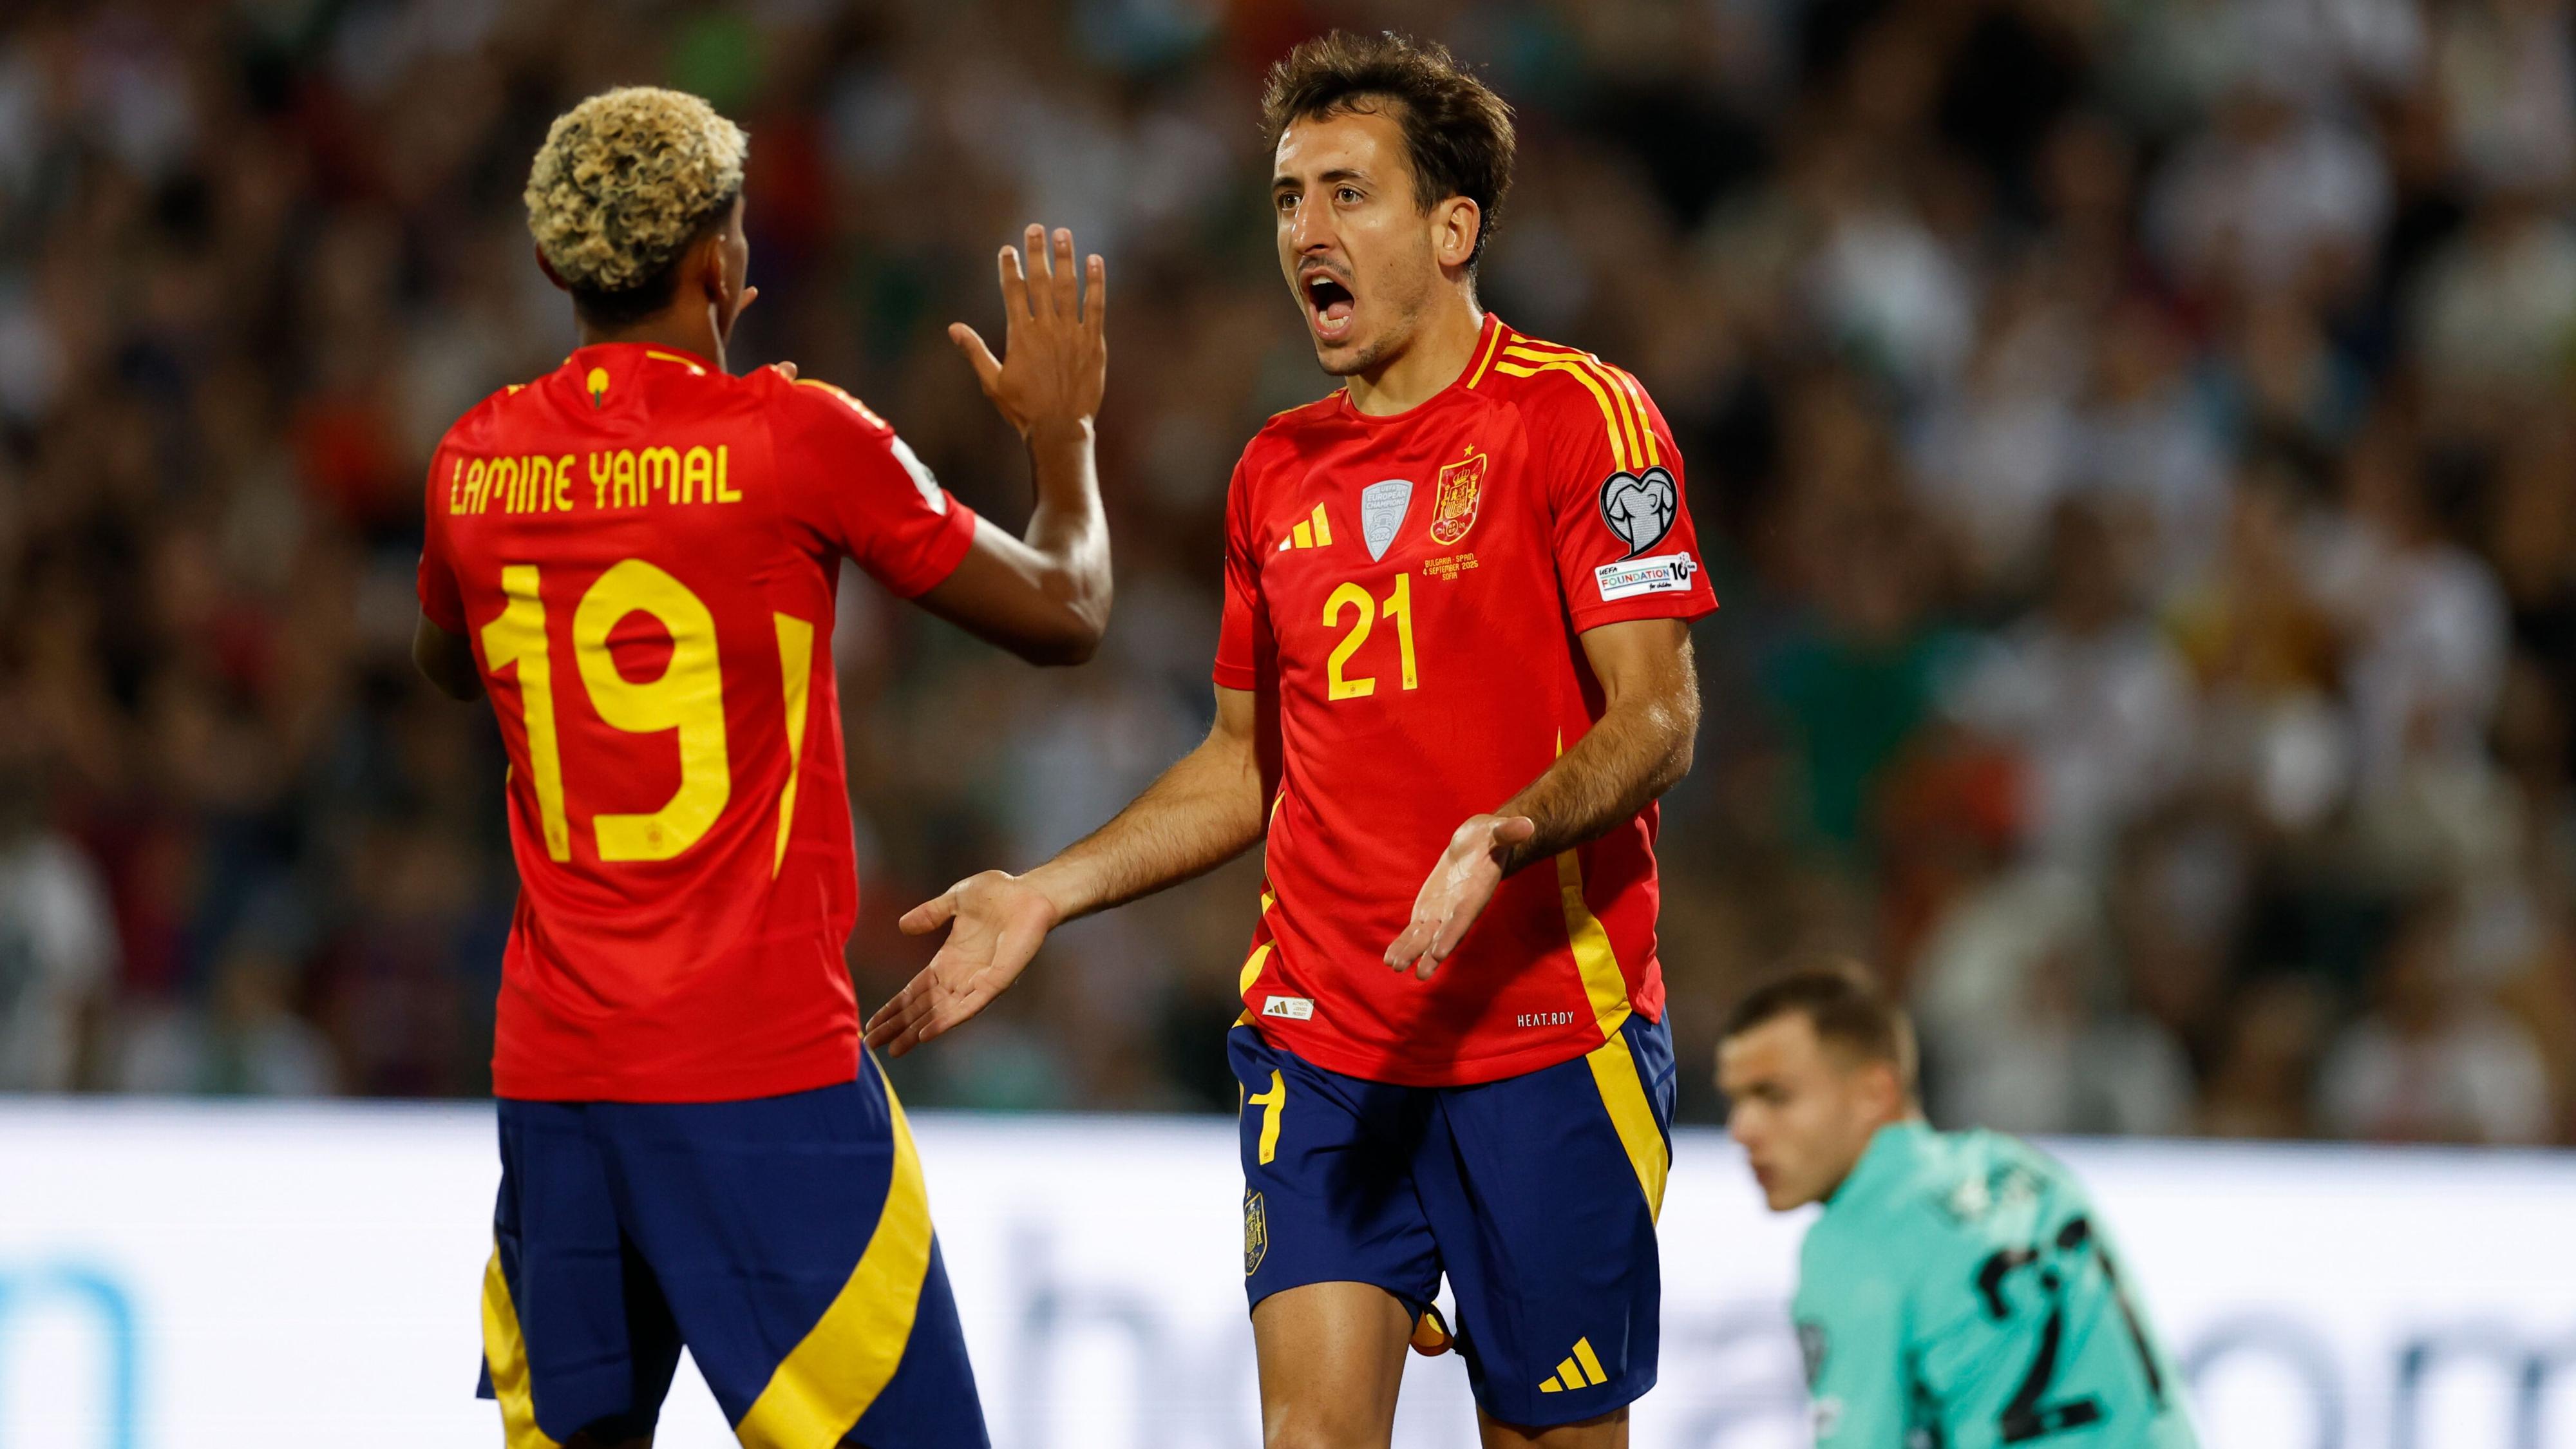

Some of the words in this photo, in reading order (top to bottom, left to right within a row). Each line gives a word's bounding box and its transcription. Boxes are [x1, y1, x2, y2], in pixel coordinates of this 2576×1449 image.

[450, 453, 576, 515] LAMINE
[589, 444, 743, 510] YAMAL
[1366, 499, 1405, 509] CHAMPIONS
[1367, 490, 1406, 502] EUROPEAN
[1370, 533, 1390, 542] 2024
[1423, 567, 1428, 576] 4
[1428, 563, 1460, 575] SEPTEMBER
[1461, 560, 1479, 570] 2025
[1425, 556, 1452, 568] BULGARIA
[1455, 553, 1474, 563] SPAIN
[1442, 571, 1458, 581] SOFIA
[1599, 566, 1618, 576] UEFA
[1602, 568, 1670, 588] FOUNDATION
[1669, 562, 1688, 580] 10
[1323, 573, 1418, 701] 21
[480, 558, 731, 863] 19
[1517, 1011, 1573, 1027] HEAT.RDY
[1977, 1215, 2169, 1443] 21
